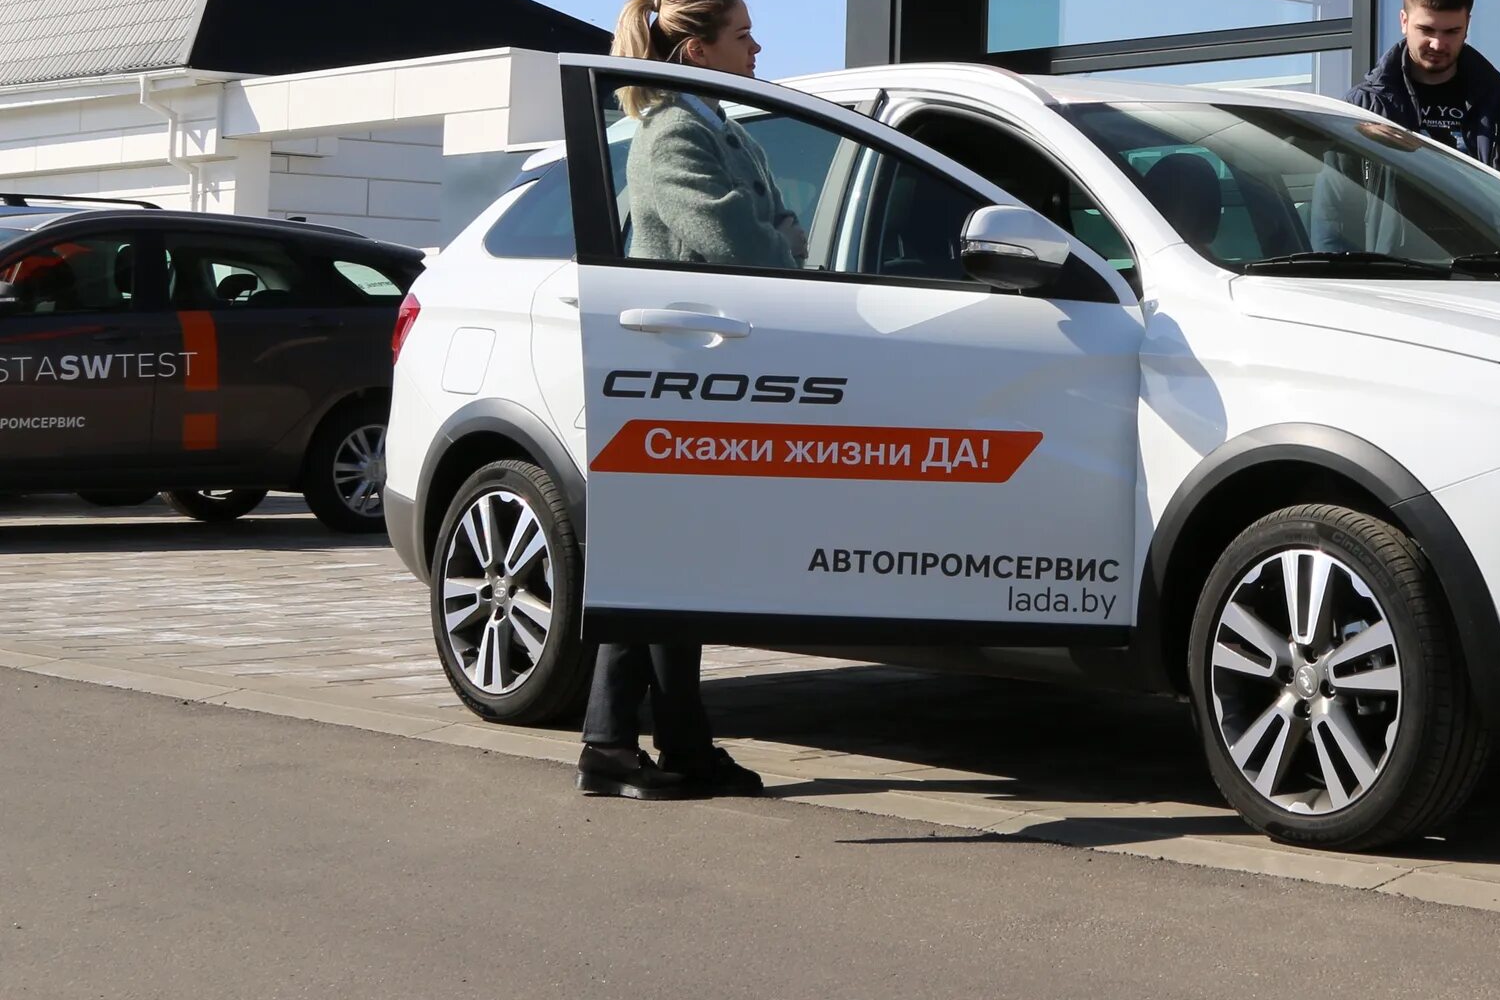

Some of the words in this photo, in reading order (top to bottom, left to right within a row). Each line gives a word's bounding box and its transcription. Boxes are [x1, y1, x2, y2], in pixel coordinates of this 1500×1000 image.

[602, 370, 848, 404] CROSS
[644, 428, 774, 464] Скажи
[783, 440, 911, 468] жизни
[920, 437, 991, 473] ДА!
[807, 548, 1120, 583] АВТОПРОМСЕРВИС
[1007, 585, 1118, 618] lada.by
